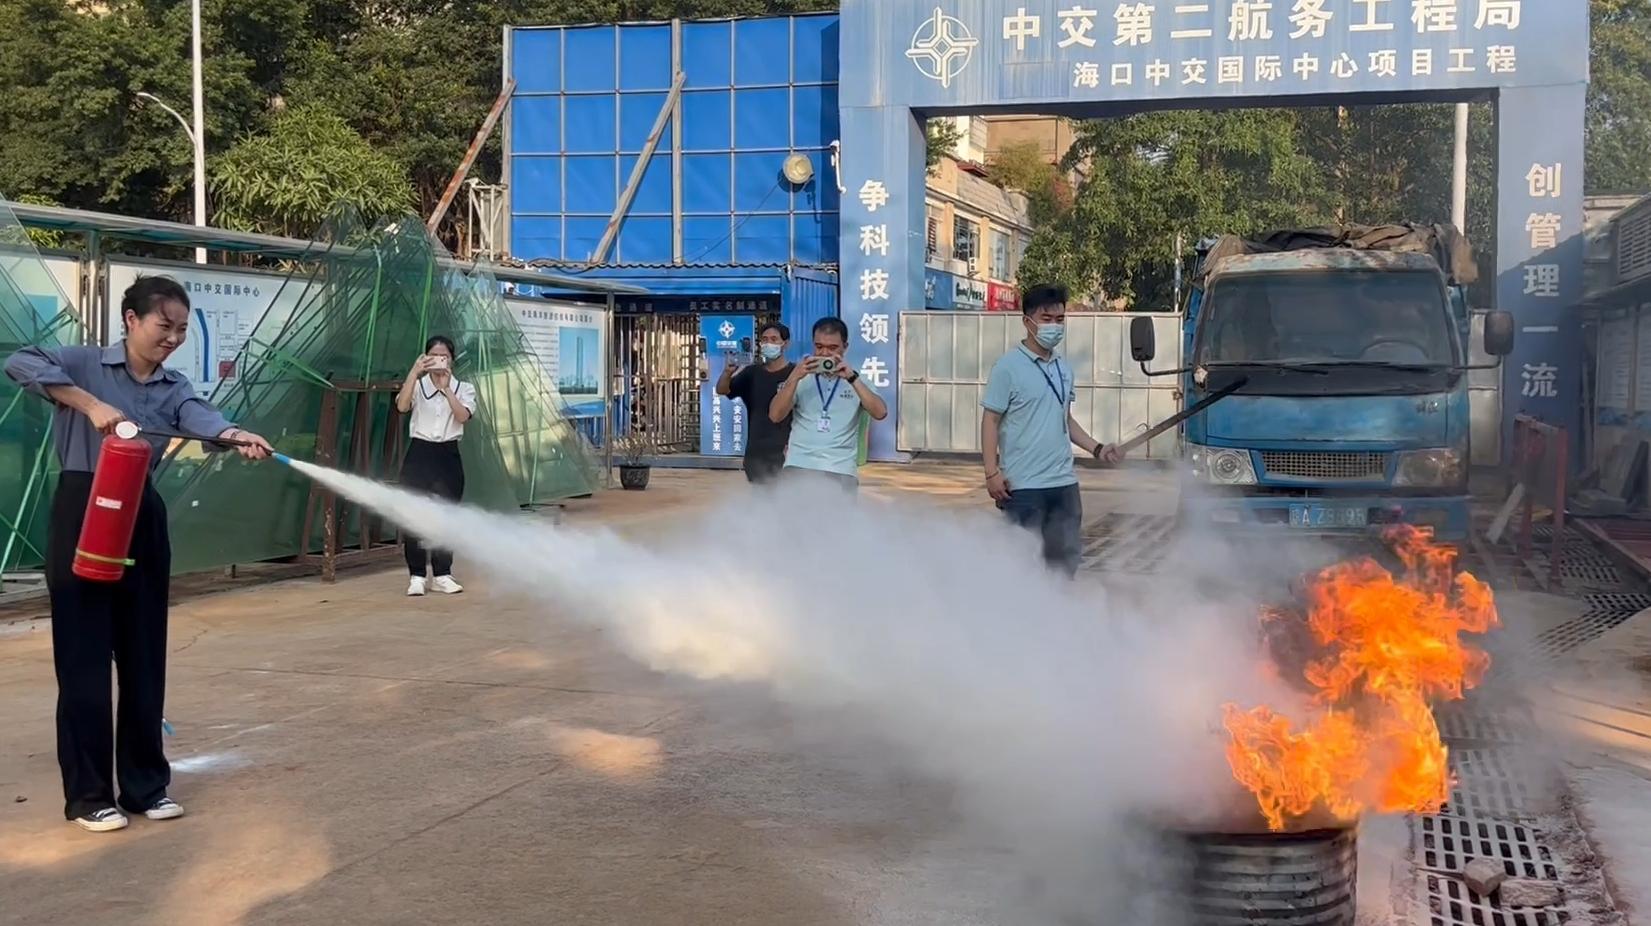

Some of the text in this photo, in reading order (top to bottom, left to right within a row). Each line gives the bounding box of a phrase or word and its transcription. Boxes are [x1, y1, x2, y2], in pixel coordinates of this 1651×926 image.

[1003, 0, 1520, 50] 中交第二航务工程局
[1073, 45, 1517, 88] 海口中交国际中心项目工程
[859, 179, 890, 388] 争科技领先
[1521, 162, 1561, 397] 创管理一流
